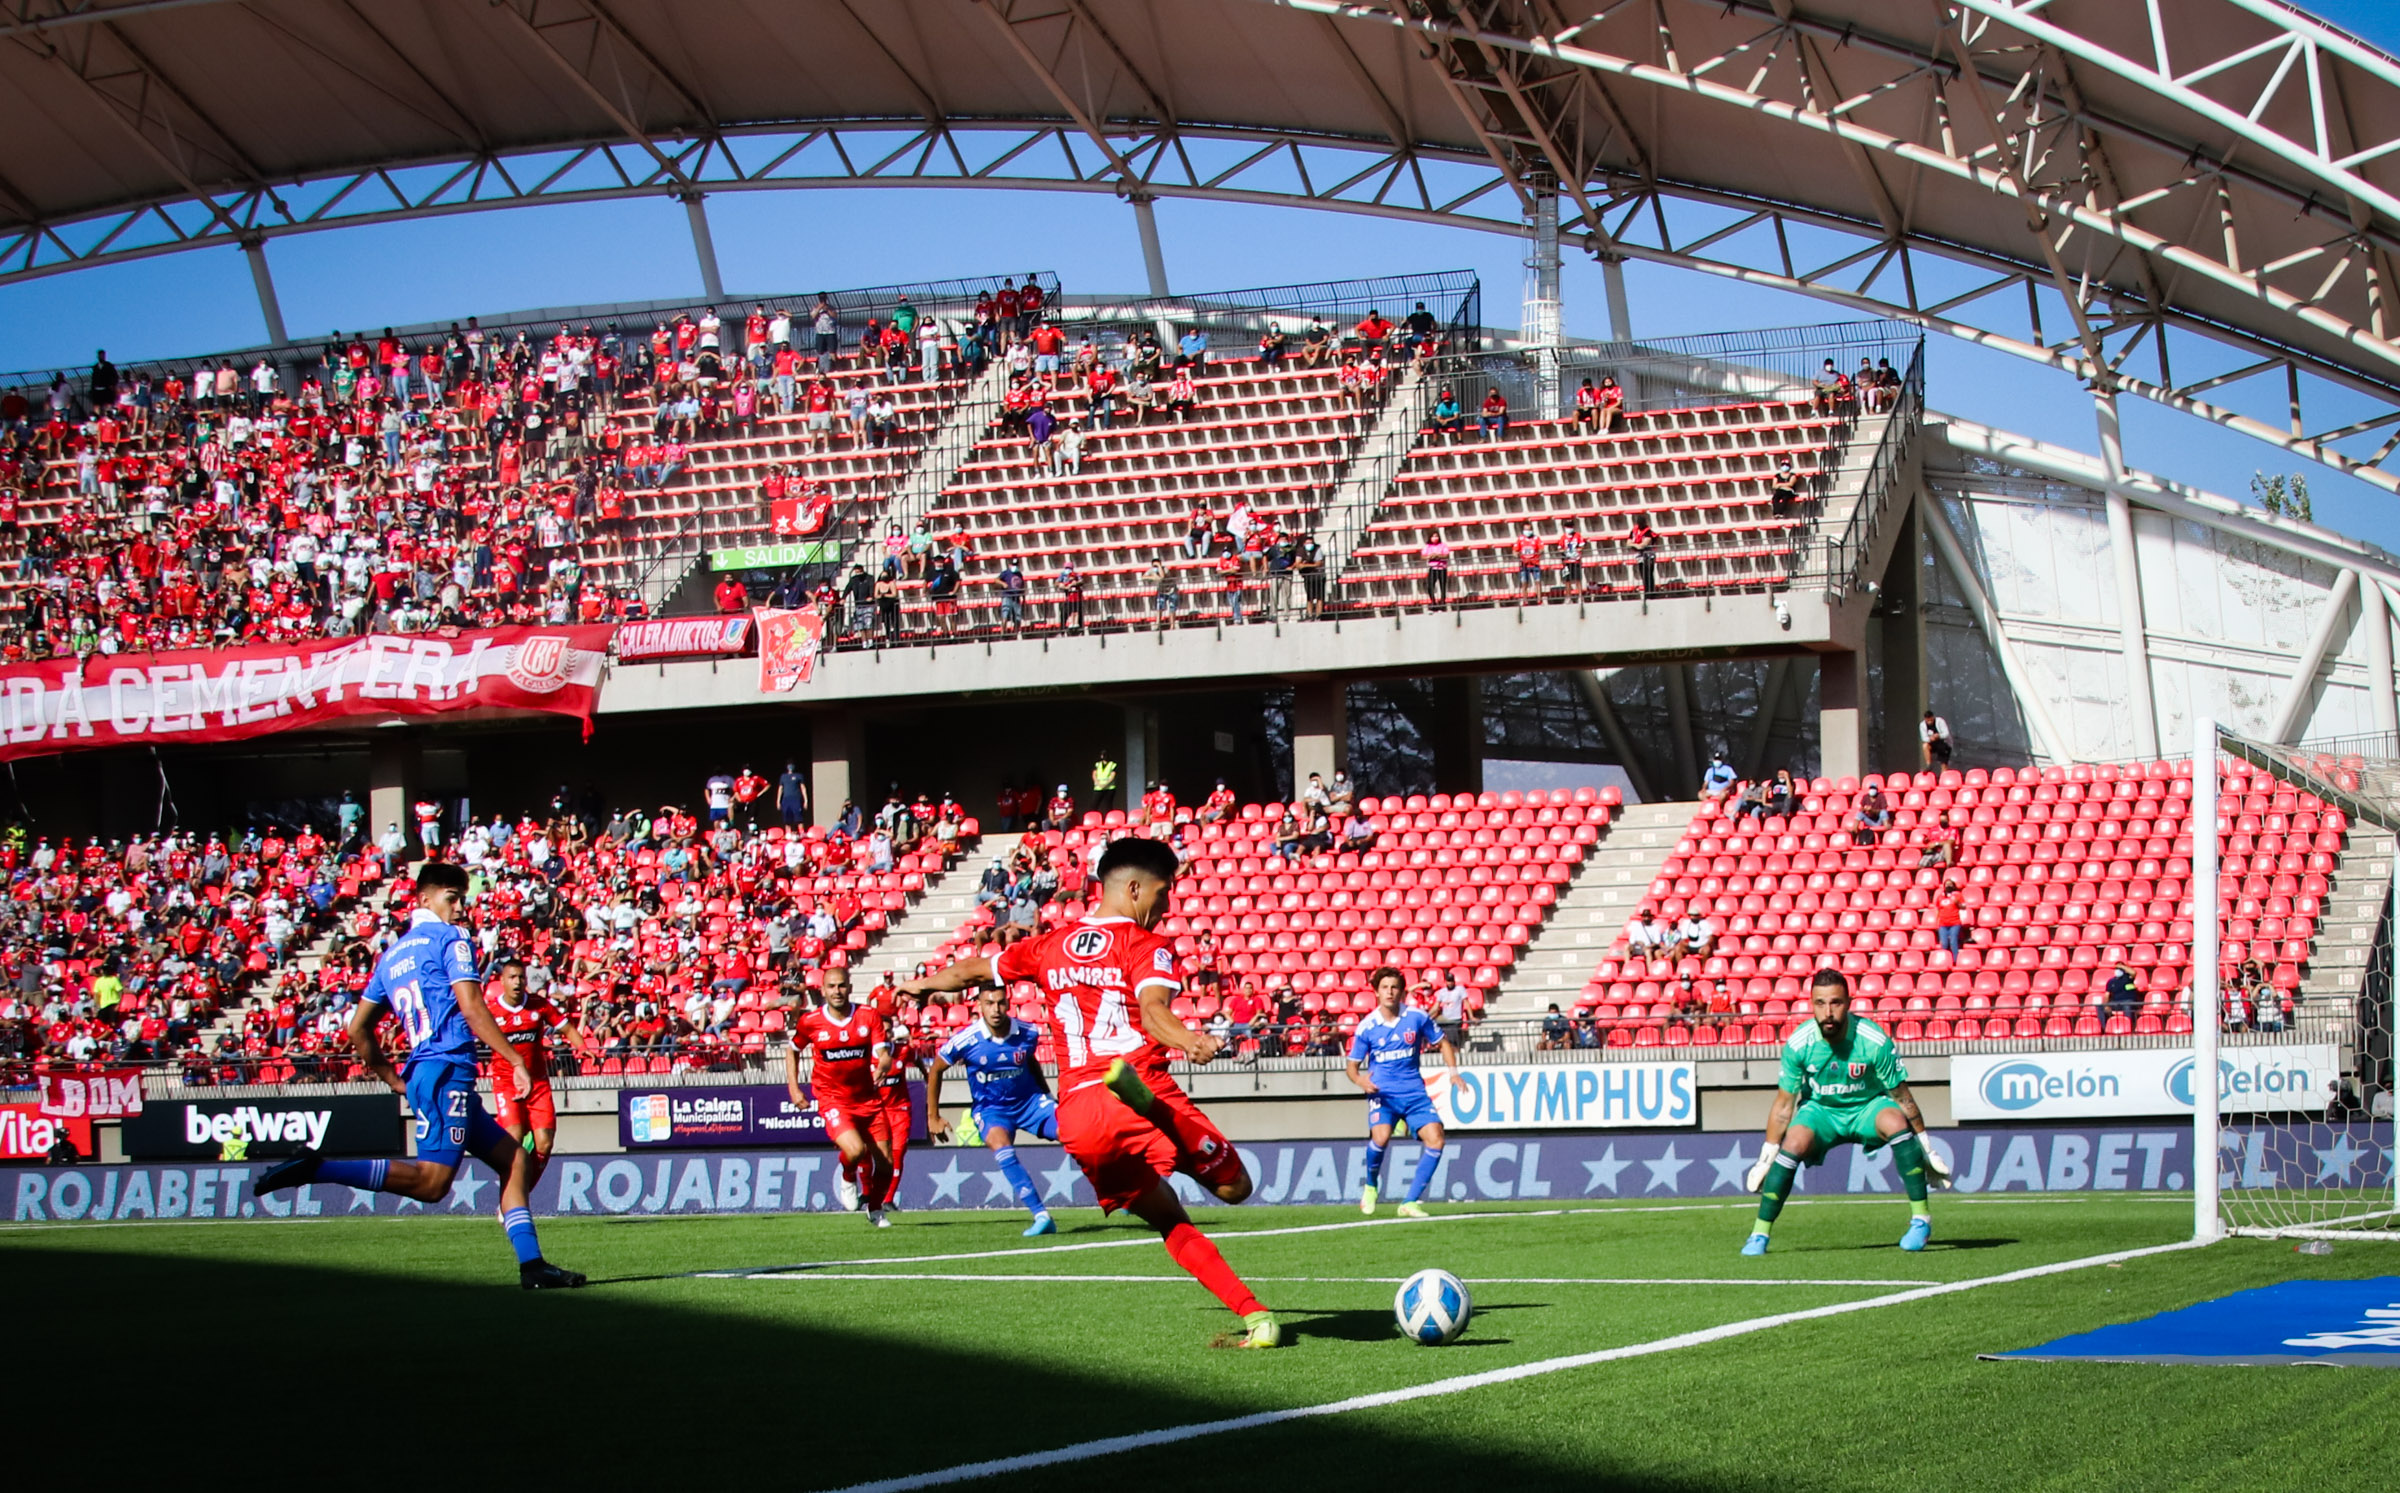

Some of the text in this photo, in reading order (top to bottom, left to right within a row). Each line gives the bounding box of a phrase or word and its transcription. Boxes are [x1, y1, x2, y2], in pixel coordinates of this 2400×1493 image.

[745, 547, 808, 567] SALIDA
[619, 620, 723, 657] CALERADIKTOS
[524, 640, 560, 675] LBC
[0, 635, 493, 746] DA CEMENTERA
[1075, 931, 1102, 954] PF
[1047, 966, 1127, 991] RAMIREZ
[394, 980, 433, 1050] 21
[1054, 990, 1148, 1068] 14
[825, 1047, 866, 1060] betway
[1847, 1062, 1867, 1079] U
[39, 1074, 143, 1117] LBDM
[1450, 1067, 1690, 1125] OLYMPHUS
[1820, 1081, 1866, 1096] BETANO
[2002, 1067, 2119, 1101] melón
[673, 1098, 743, 1113] La Calera
[673, 1111, 743, 1125] Municipalidad
[186, 1105, 332, 1150] betway
[450, 1127, 466, 1145] U
[557, 1156, 901, 1214] ROJABET.
